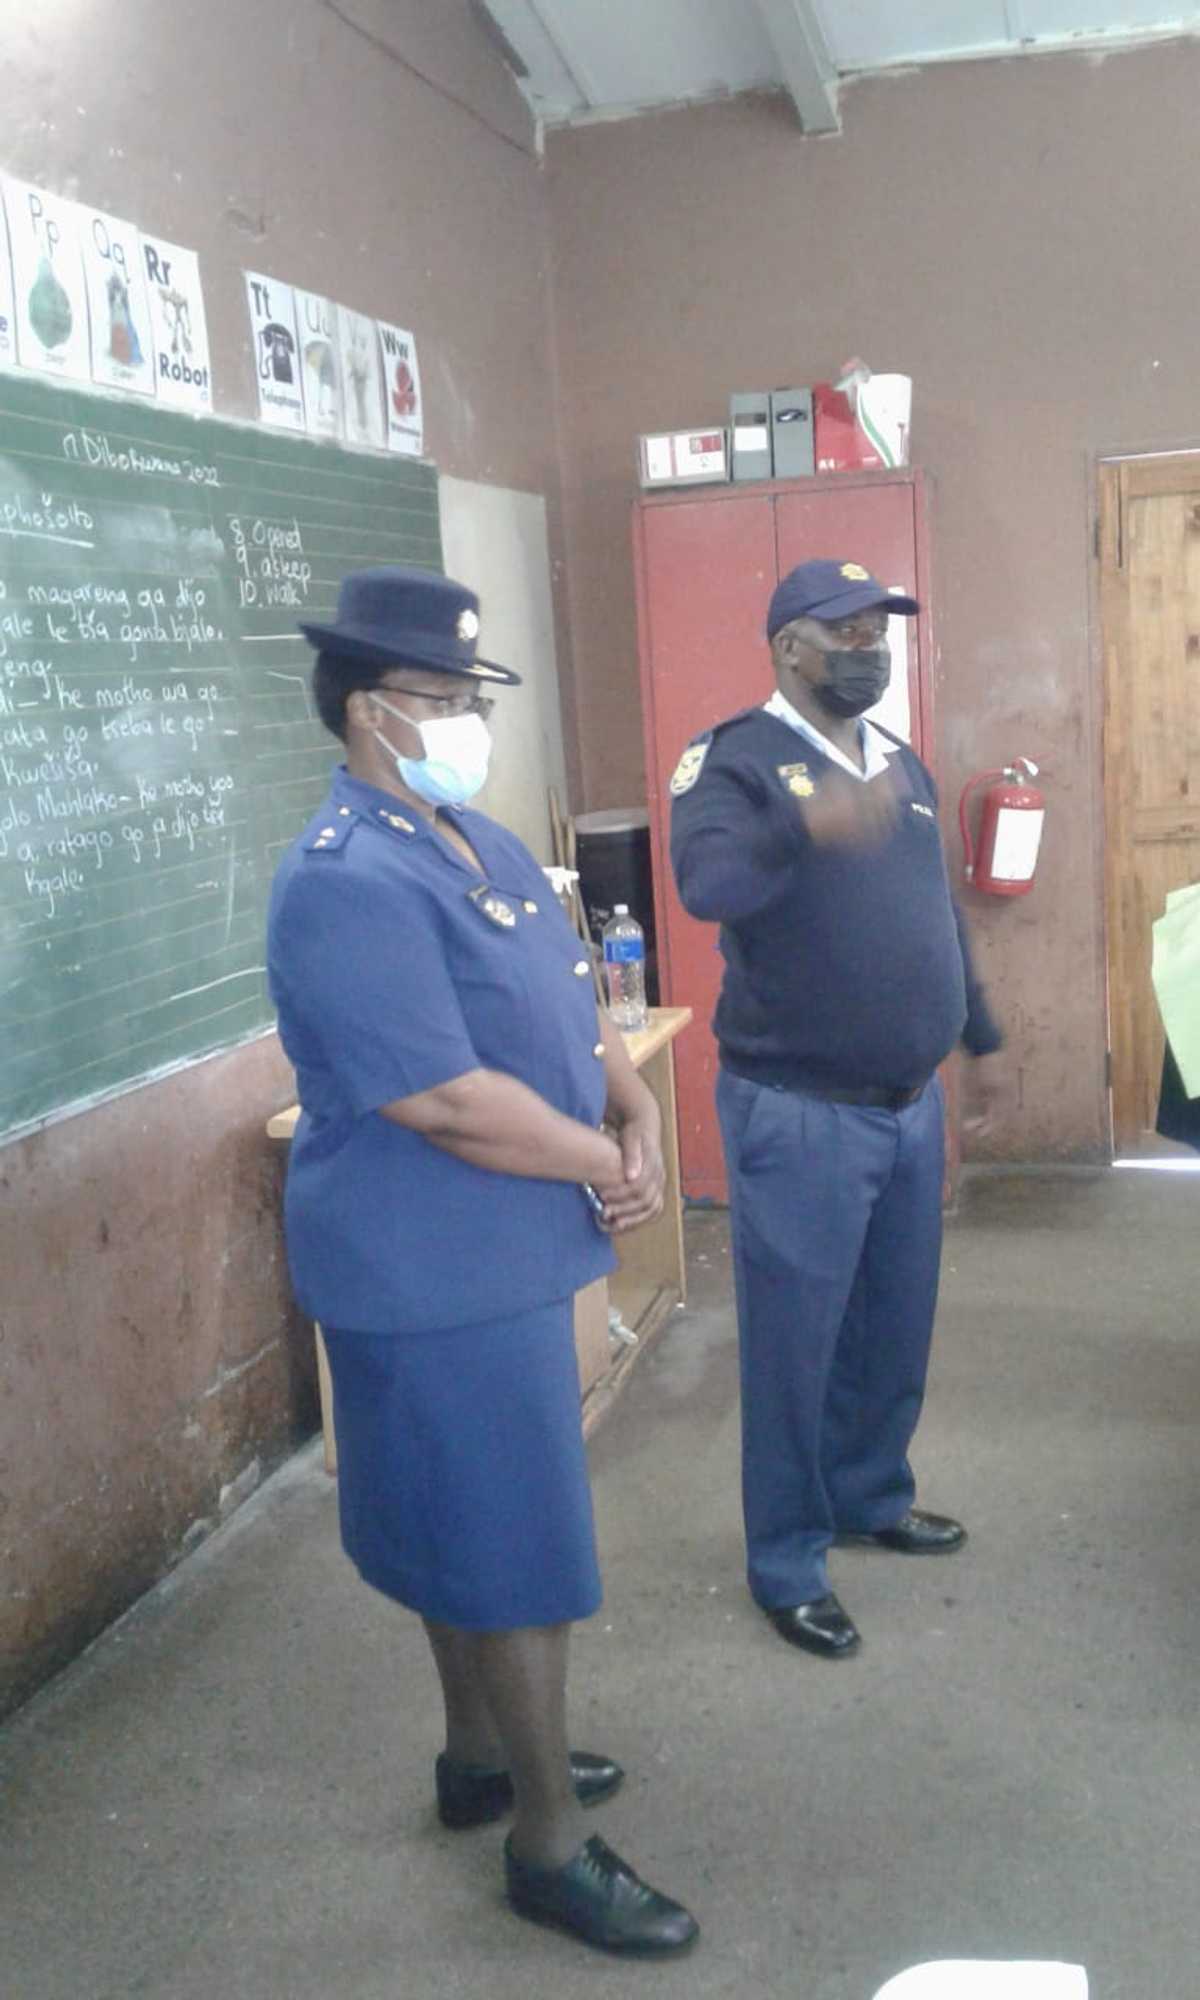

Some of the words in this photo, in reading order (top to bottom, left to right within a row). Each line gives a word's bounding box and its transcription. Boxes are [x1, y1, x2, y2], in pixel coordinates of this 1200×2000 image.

[144, 244, 172, 286] Rr
[250, 277, 272, 320] Tt
[159, 352, 209, 388] Robot
[96, 675, 152, 708] motho
